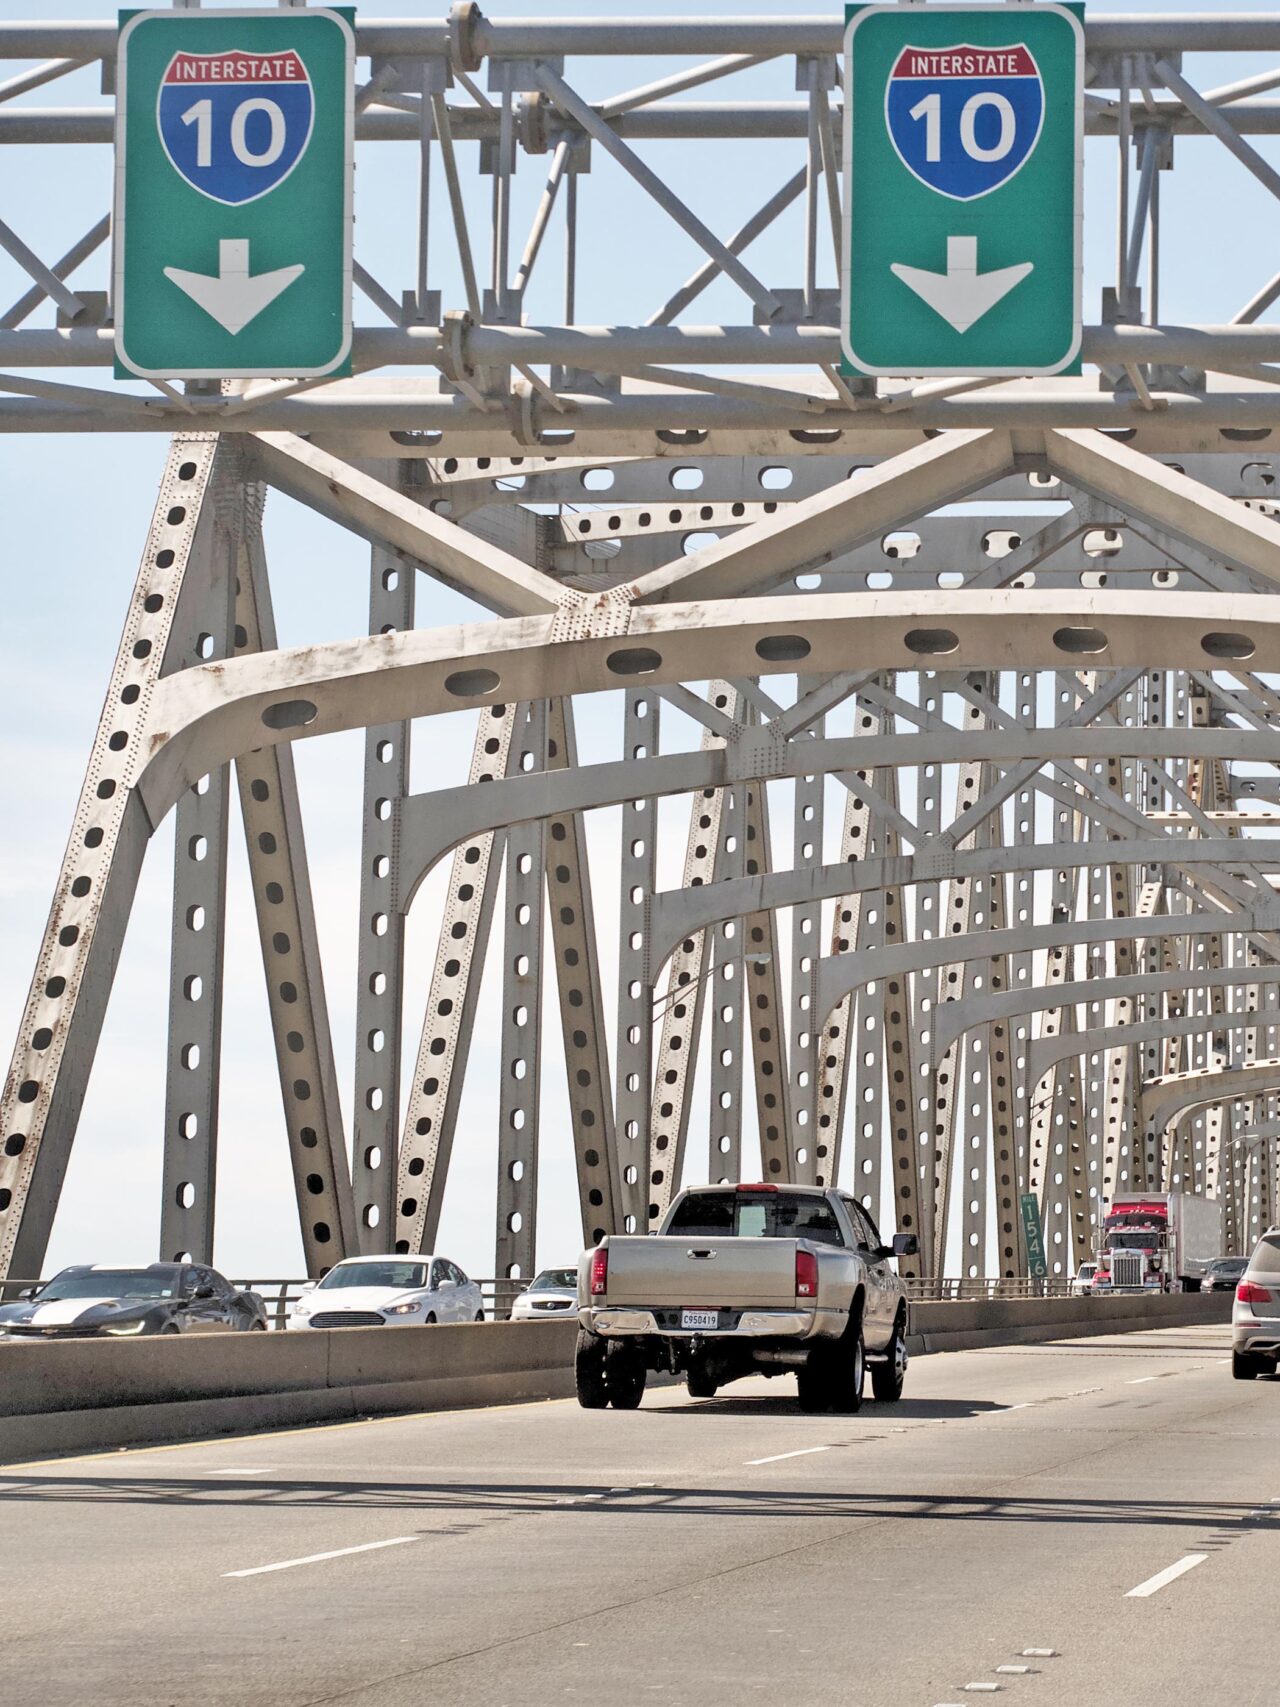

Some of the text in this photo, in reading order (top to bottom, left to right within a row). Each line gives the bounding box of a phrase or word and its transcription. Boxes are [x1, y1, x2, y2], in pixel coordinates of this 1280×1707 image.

[176, 59, 296, 80] INTERSTATE
[911, 54, 1018, 75] INTERSTATE
[180, 97, 286, 167] 10
[909, 92, 1016, 163] 10
[683, 1315, 716, 1325] C950419
